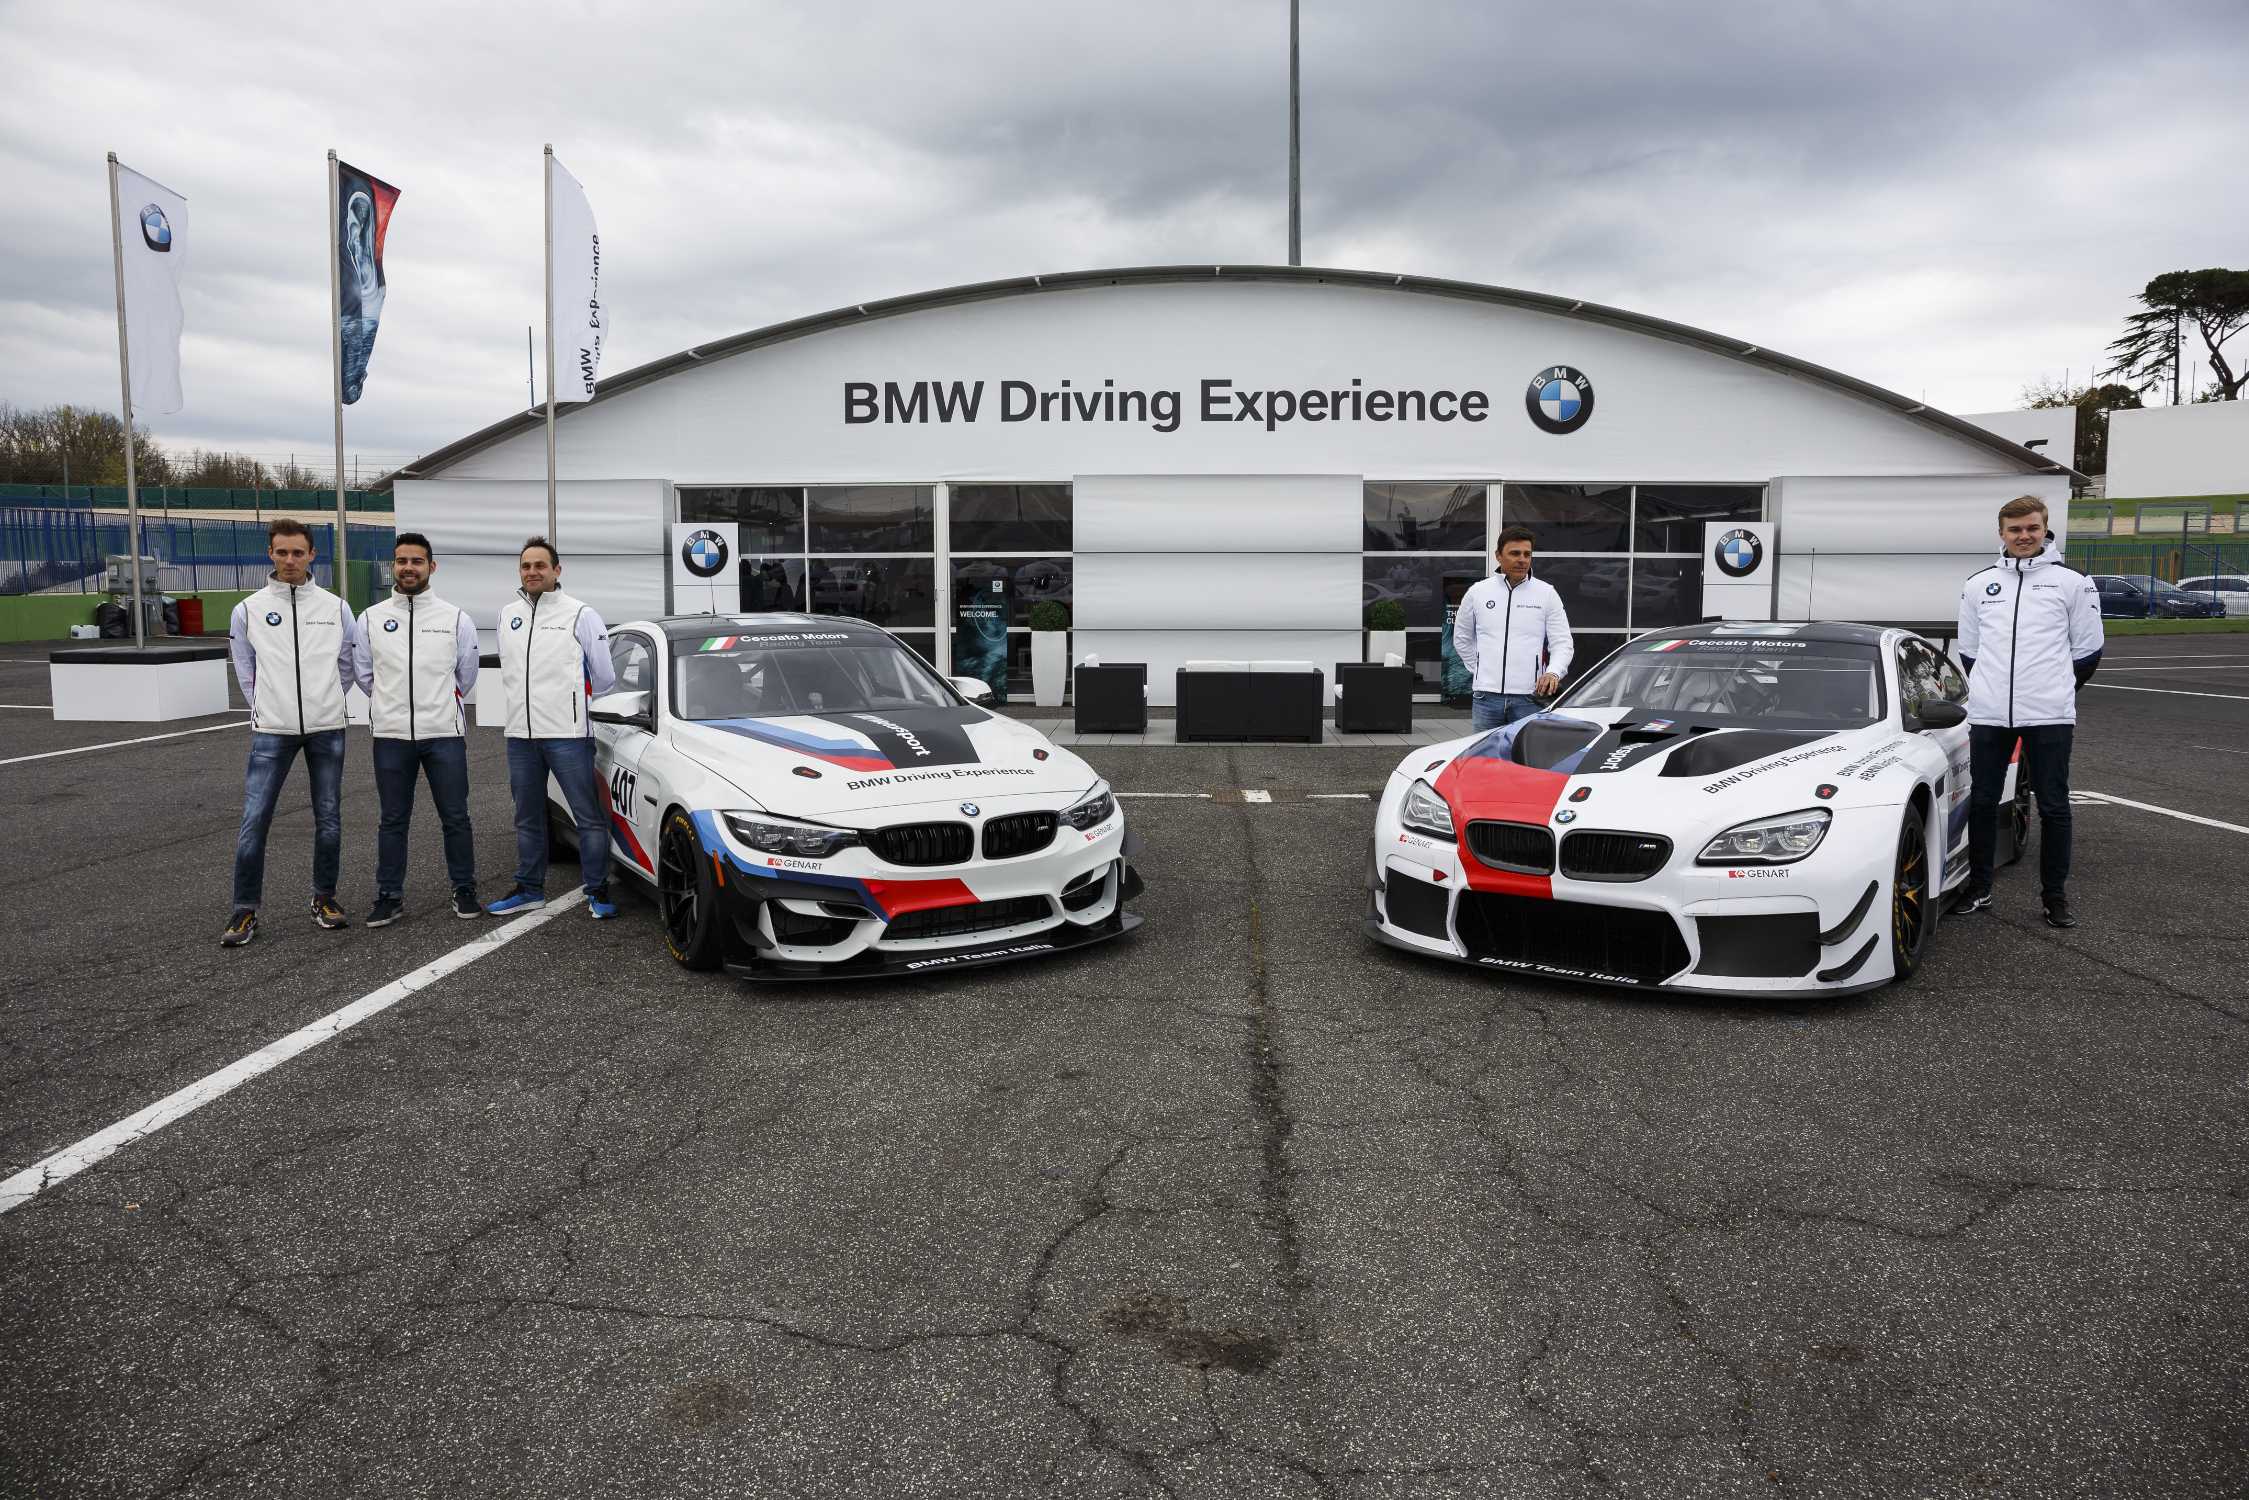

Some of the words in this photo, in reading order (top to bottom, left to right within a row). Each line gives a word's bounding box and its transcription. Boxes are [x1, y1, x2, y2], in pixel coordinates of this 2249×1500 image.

[589, 234, 600, 328] Epience
[844, 380, 983, 424] BMW
[1001, 379, 1181, 432] Driving
[1201, 379, 1489, 432] Experience
[740, 634, 799, 642] Ceccato
[802, 632, 849, 640] Motors
[1752, 640, 1807, 648] Motors
[847, 776, 893, 791] BMW
[894, 769, 952, 783] Driving
[952, 767, 1035, 777] Experience
[1703, 774, 1742, 794] BMW
[1740, 760, 1786, 779] Driving
[1783, 744, 1847, 767] Experience
[611, 767, 636, 818] 407
[784, 859, 822, 871] GENART
[1747, 869, 1790, 878] GENART
[906, 956, 958, 970] BMW
[957, 949, 1009, 961] Team
[1009, 943, 1055, 953] Italia
[1479, 957, 1533, 968] BMW
[1536, 964, 1584, 976] Team
[1589, 972, 1639, 984] Italia
